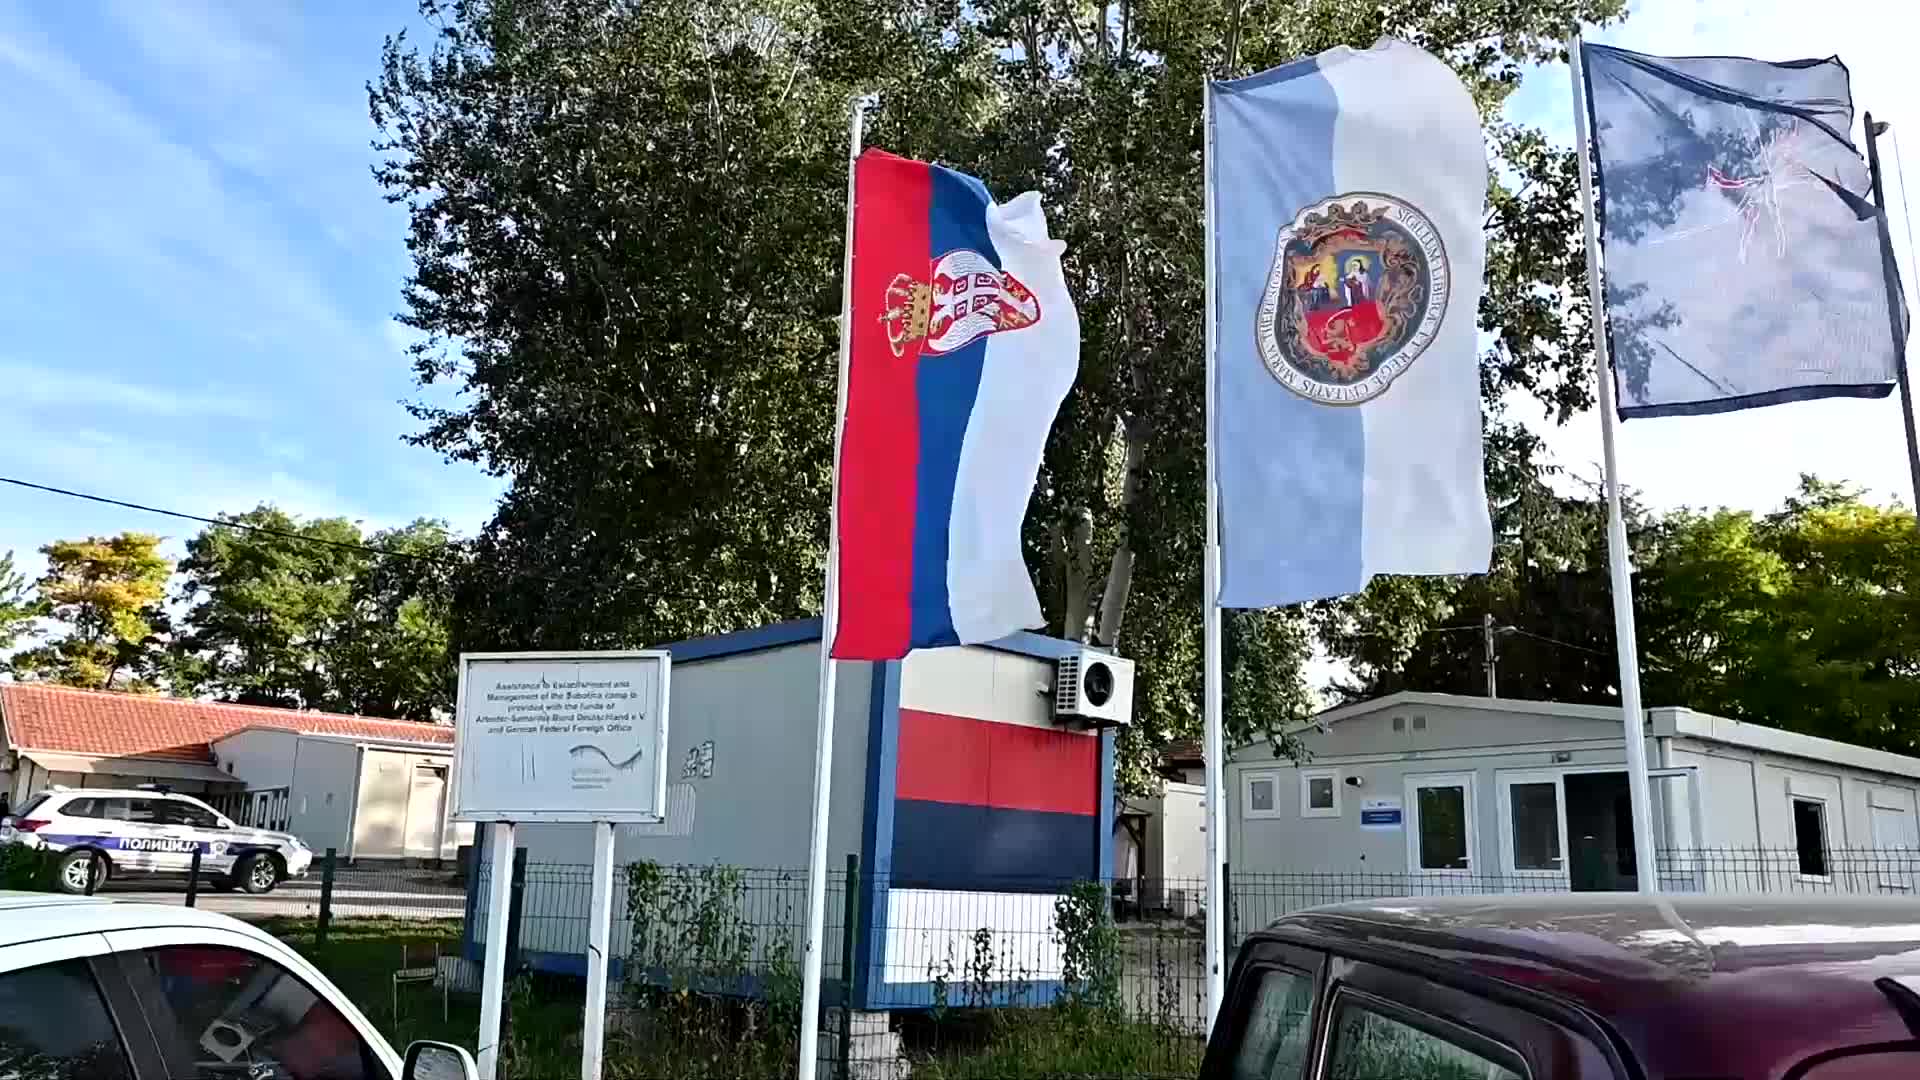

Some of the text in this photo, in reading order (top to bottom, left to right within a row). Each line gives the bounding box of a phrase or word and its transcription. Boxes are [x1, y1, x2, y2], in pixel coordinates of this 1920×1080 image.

[487, 693, 538, 702] Management
[541, 692, 549, 700] of
[551, 692, 564, 700] the
[566, 691, 602, 700] Subotica
[605, 692, 628, 701] camp
[507, 703, 544, 712] provided
[564, 702, 577, 710] the
[580, 701, 604, 710] funds
[606, 701, 615, 710] of
[487, 723, 632, 735] and German Federal Foreign Office
[119, 837, 200, 853] ПОЛИЦИЈА
